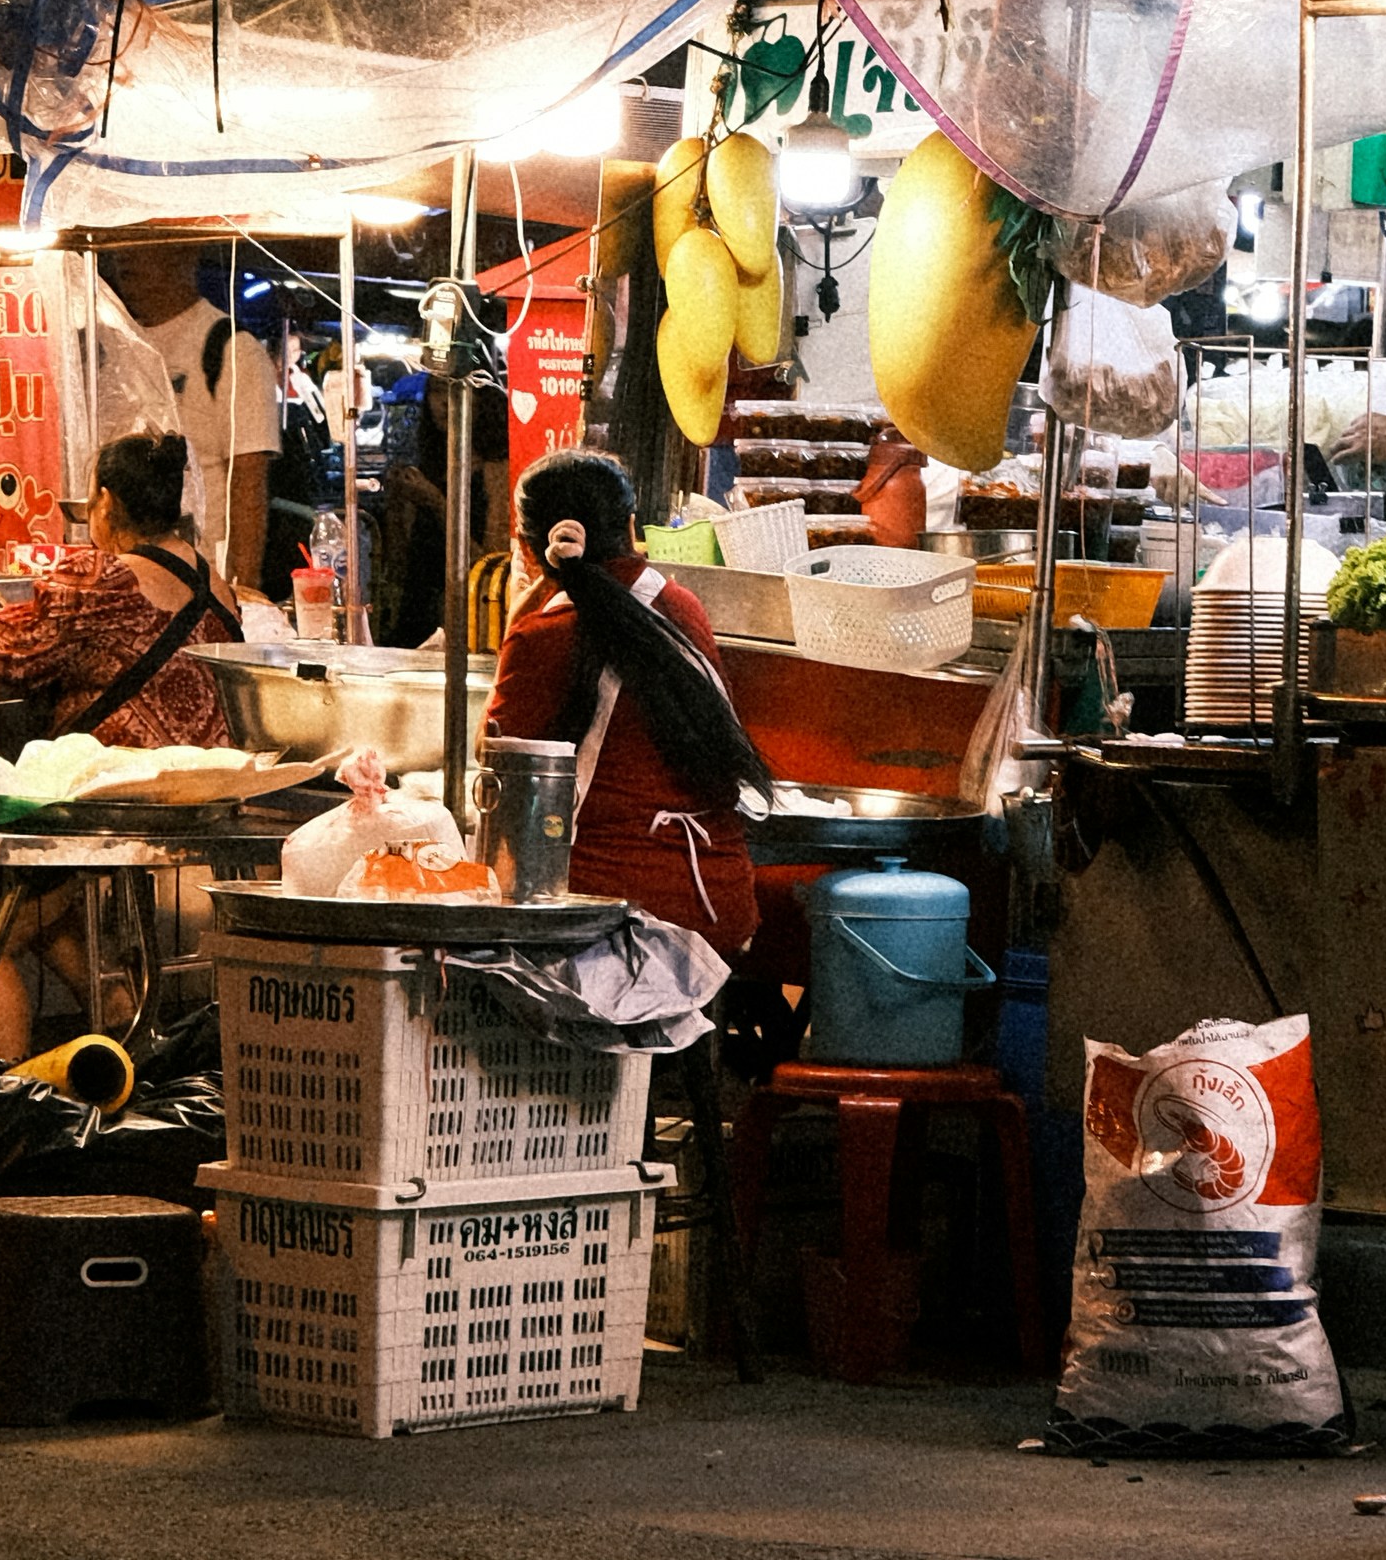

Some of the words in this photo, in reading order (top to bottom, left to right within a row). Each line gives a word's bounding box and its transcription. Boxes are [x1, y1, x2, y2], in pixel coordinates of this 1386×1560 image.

[1192, 1068, 1245, 1112] กุ้งเล็ก
[464, 1242, 570, 1262] 064-1519156
